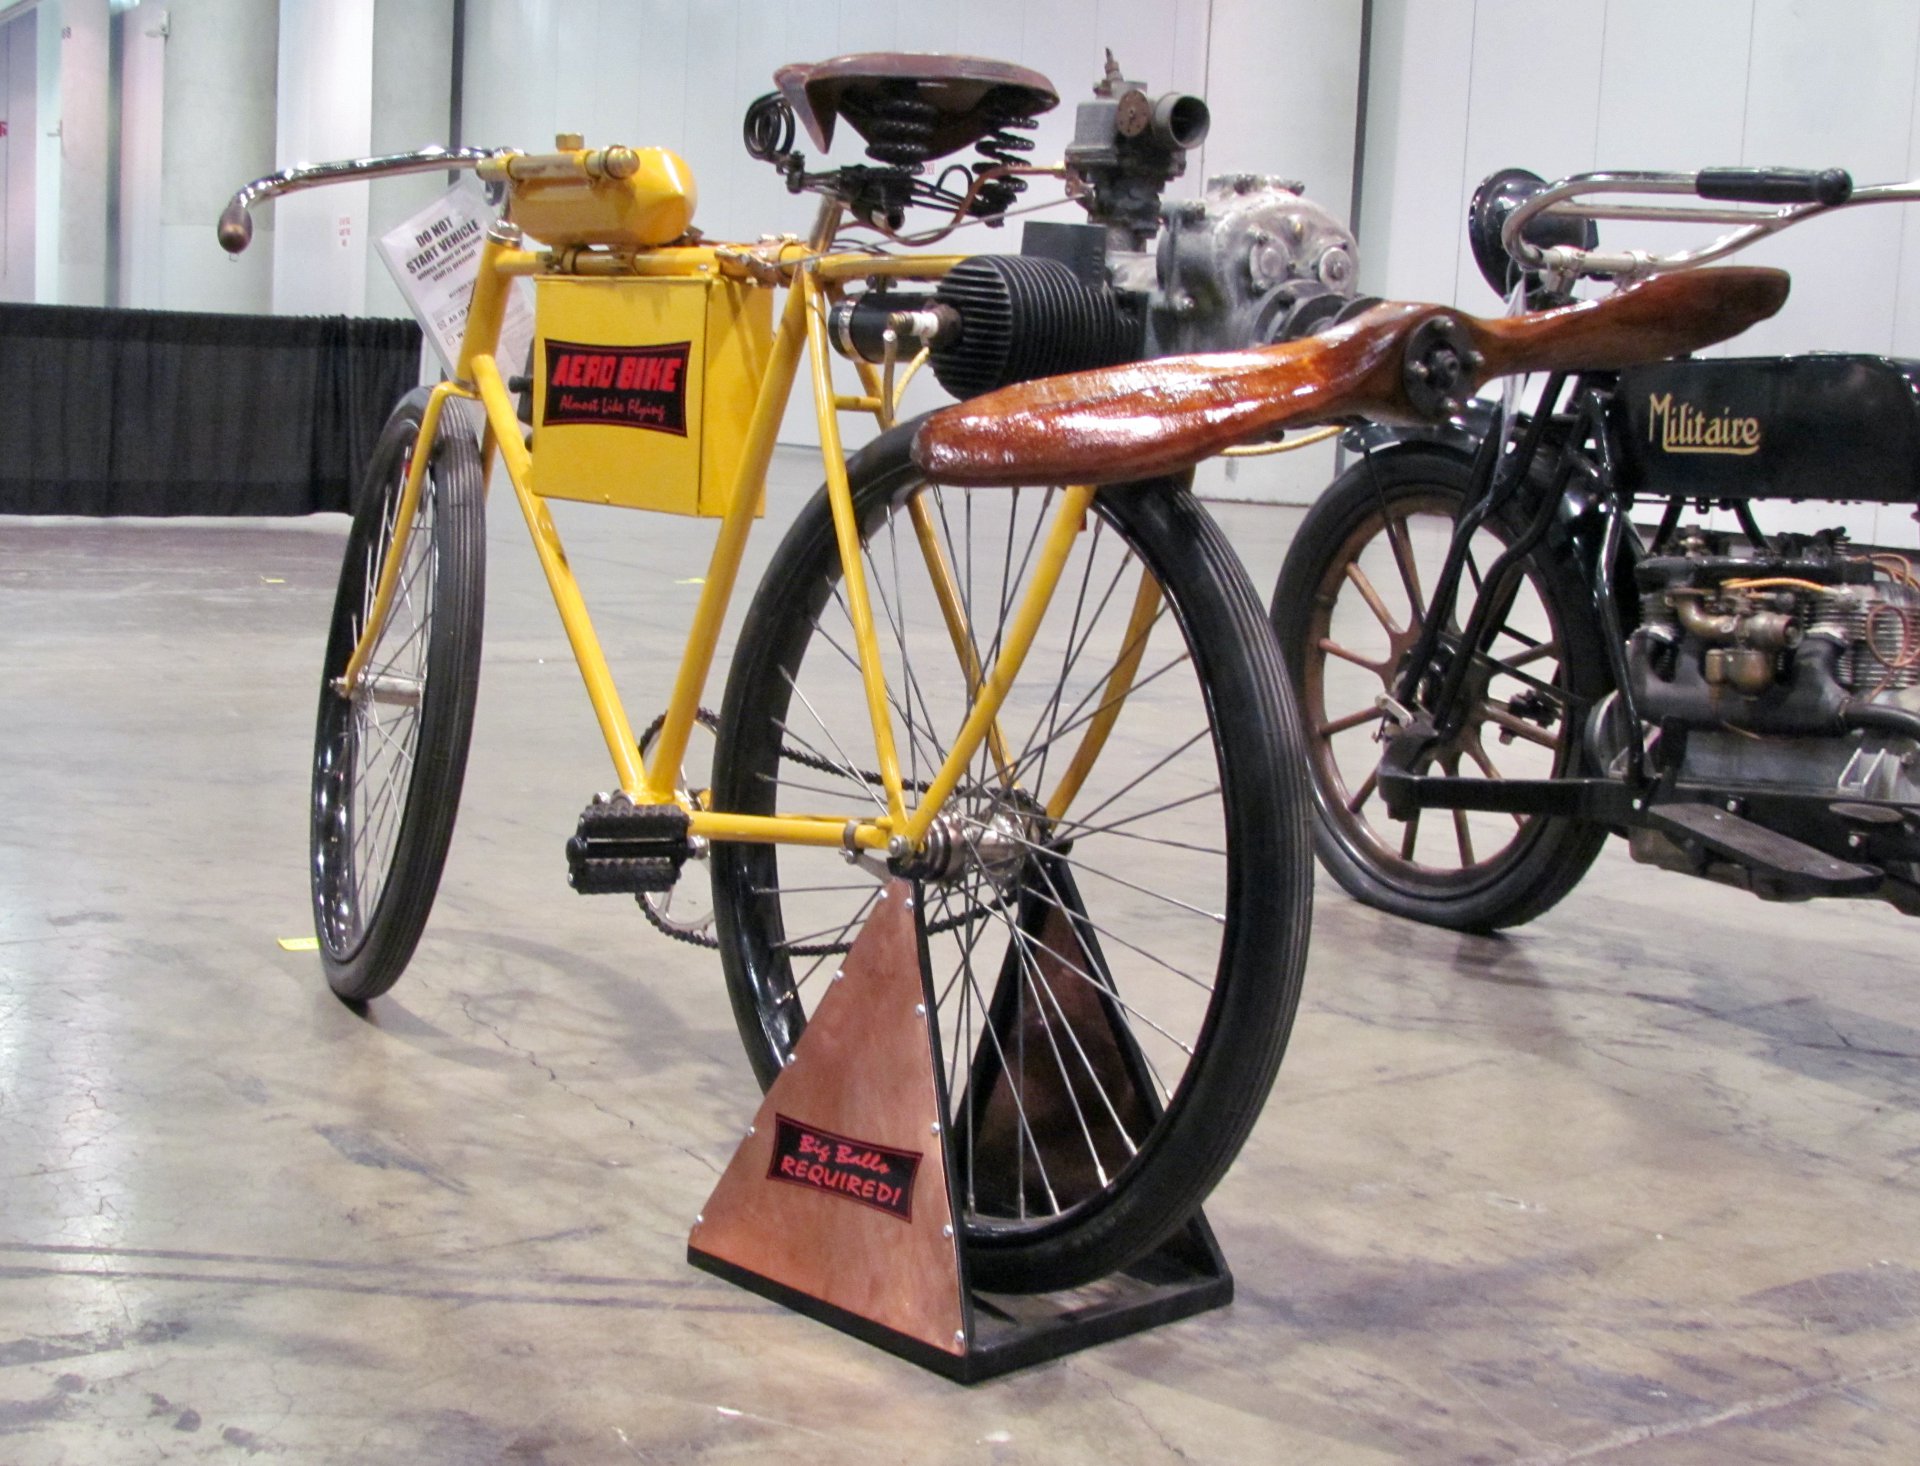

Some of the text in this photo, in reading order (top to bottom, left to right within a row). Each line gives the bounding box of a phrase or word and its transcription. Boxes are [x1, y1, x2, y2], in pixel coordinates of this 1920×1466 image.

[406, 219, 480, 274] START VEHICLE
[415, 216, 453, 248] DO NOT
[417, 265, 437, 280] unless
[552, 354, 682, 392] AERO BIKE
[559, 394, 665, 422] Almost Like Flying
[1649, 392, 1761, 455] Militaire
[799, 1134, 890, 1175] Big Balls
[780, 1155, 902, 1206] REQUIRED!
